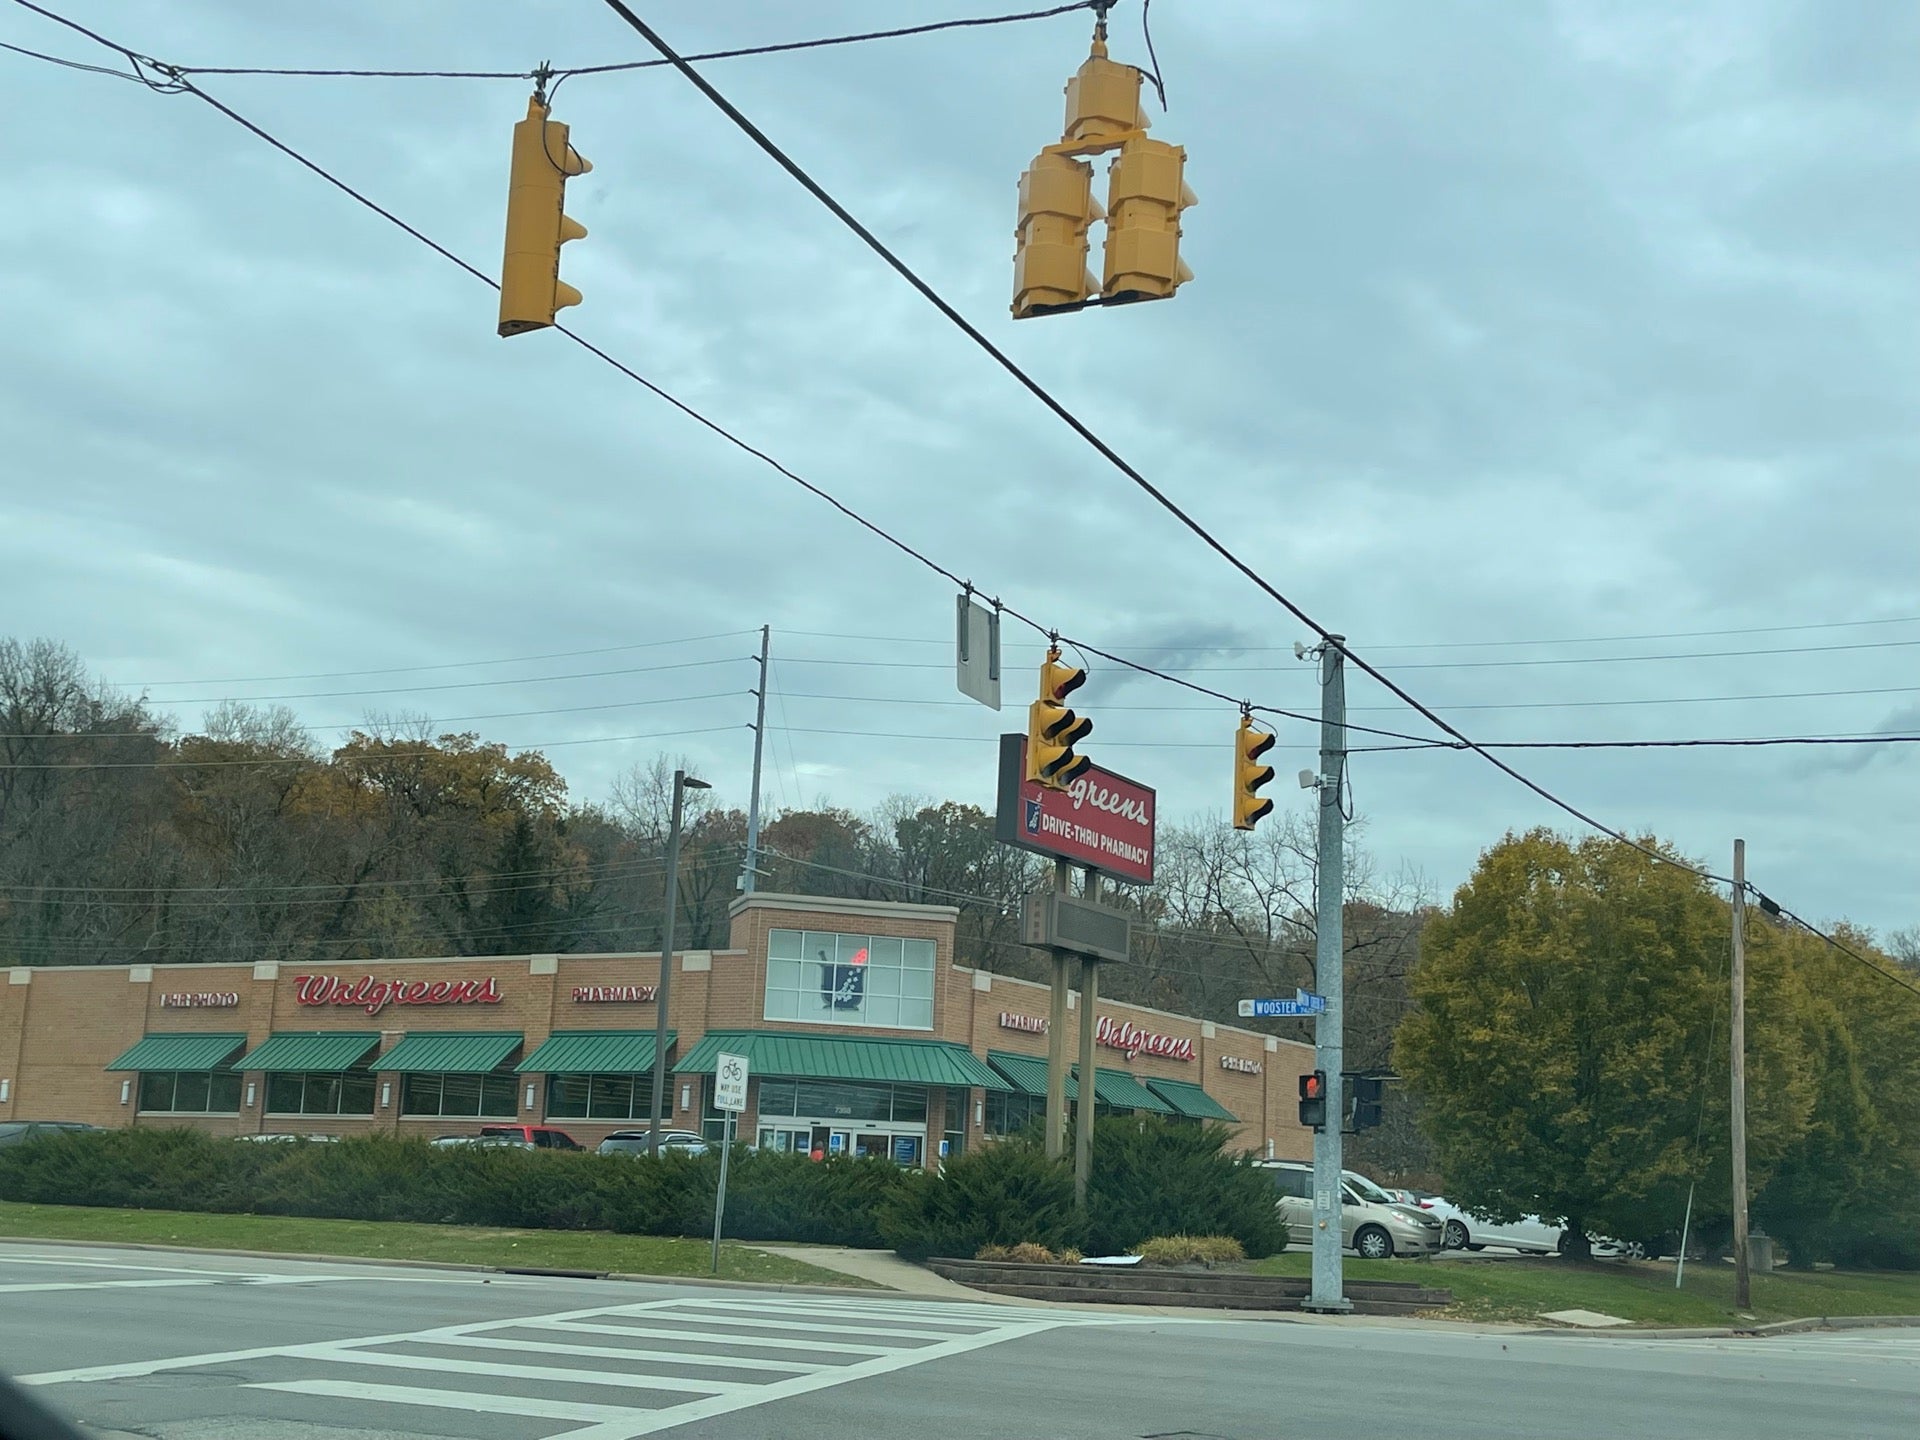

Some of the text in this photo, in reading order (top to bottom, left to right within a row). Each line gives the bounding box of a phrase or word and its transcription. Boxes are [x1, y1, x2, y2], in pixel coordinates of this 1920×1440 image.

[1042, 813, 1149, 866] DRIVE-THRU PHARMACY
[191, 992, 239, 1007] PHOTO
[293, 975, 504, 1016] Walgreens
[571, 986, 658, 1002] PHARMACY
[1256, 1001, 1297, 1014] WOOSTER
